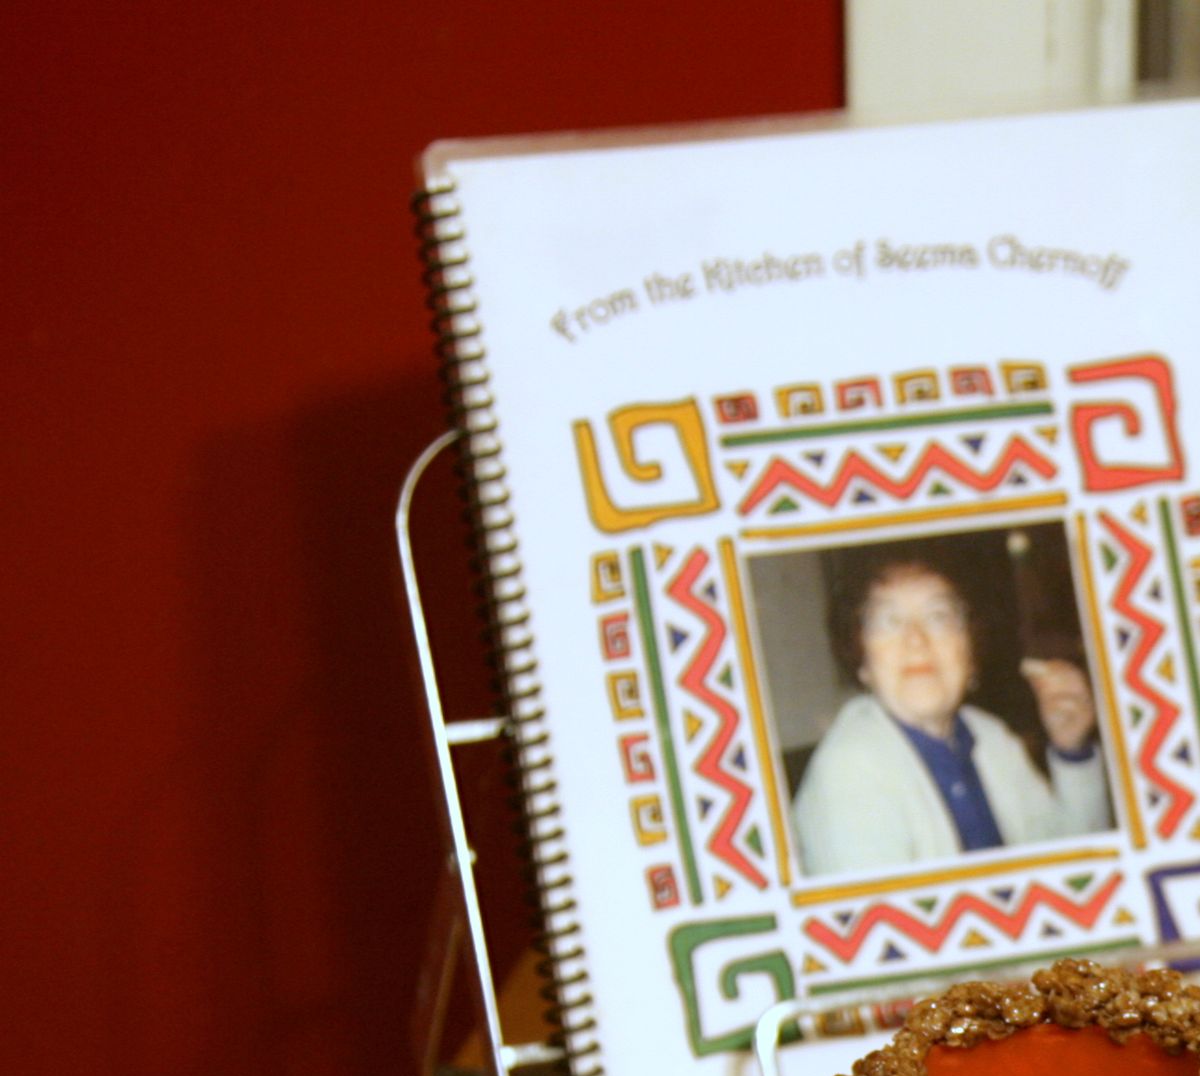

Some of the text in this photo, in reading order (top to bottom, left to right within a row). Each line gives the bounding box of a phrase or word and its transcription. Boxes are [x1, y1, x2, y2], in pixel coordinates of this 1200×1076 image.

[549, 286, 639, 343] From
[643, 270, 697, 306] the
[702, 250, 826, 294] Kitchen
[831, 238, 867, 281] of
